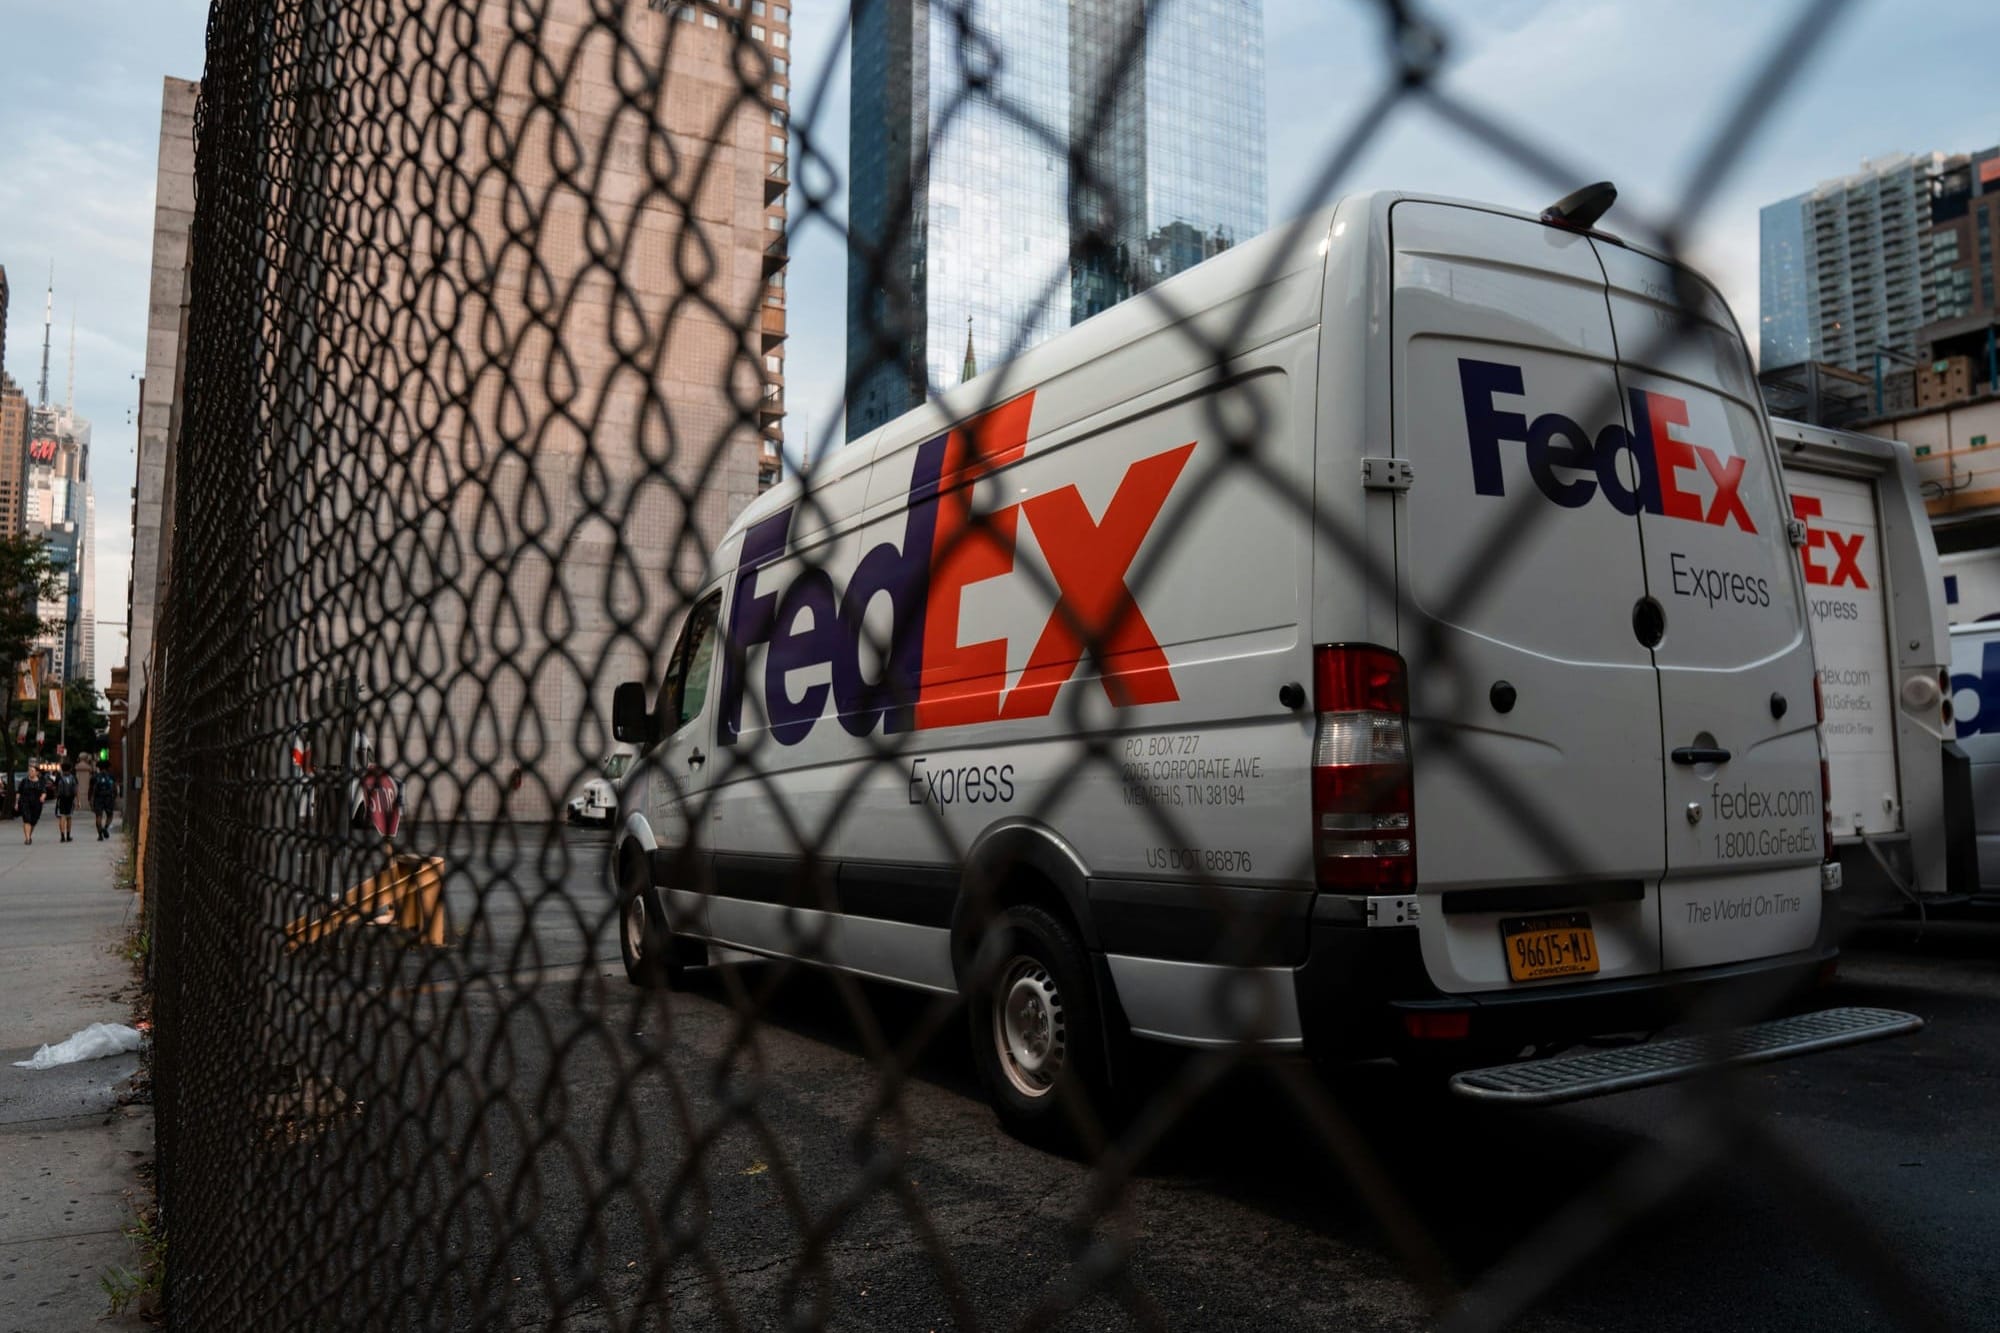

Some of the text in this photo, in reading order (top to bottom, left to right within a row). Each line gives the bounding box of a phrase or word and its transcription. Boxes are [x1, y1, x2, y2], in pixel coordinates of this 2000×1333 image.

[1457, 357, 1759, 535] FedEx
[717, 389, 1198, 747] FedEx
[1670, 552, 1770, 609] Express
[1811, 599, 1858, 622] xpress
[1816, 665, 1871, 686] dex.com
[1149, 736, 1174, 756] BOX
[1177, 735, 1200, 755] 727
[1152, 758, 1230, 781] CORPORATE
[1233, 757, 1264, 779] AVE.
[909, 758, 1014, 816] Express
[1185, 784, 1202, 805] TN
[1206, 784, 1245, 806] 38194
[1712, 782, 1815, 820] fedex.com
[1714, 827, 1817, 859] 1.800.GoFedEx
[1146, 848, 1252, 873] US DOT 86876
[1686, 893, 1800, 924] The World On Time
